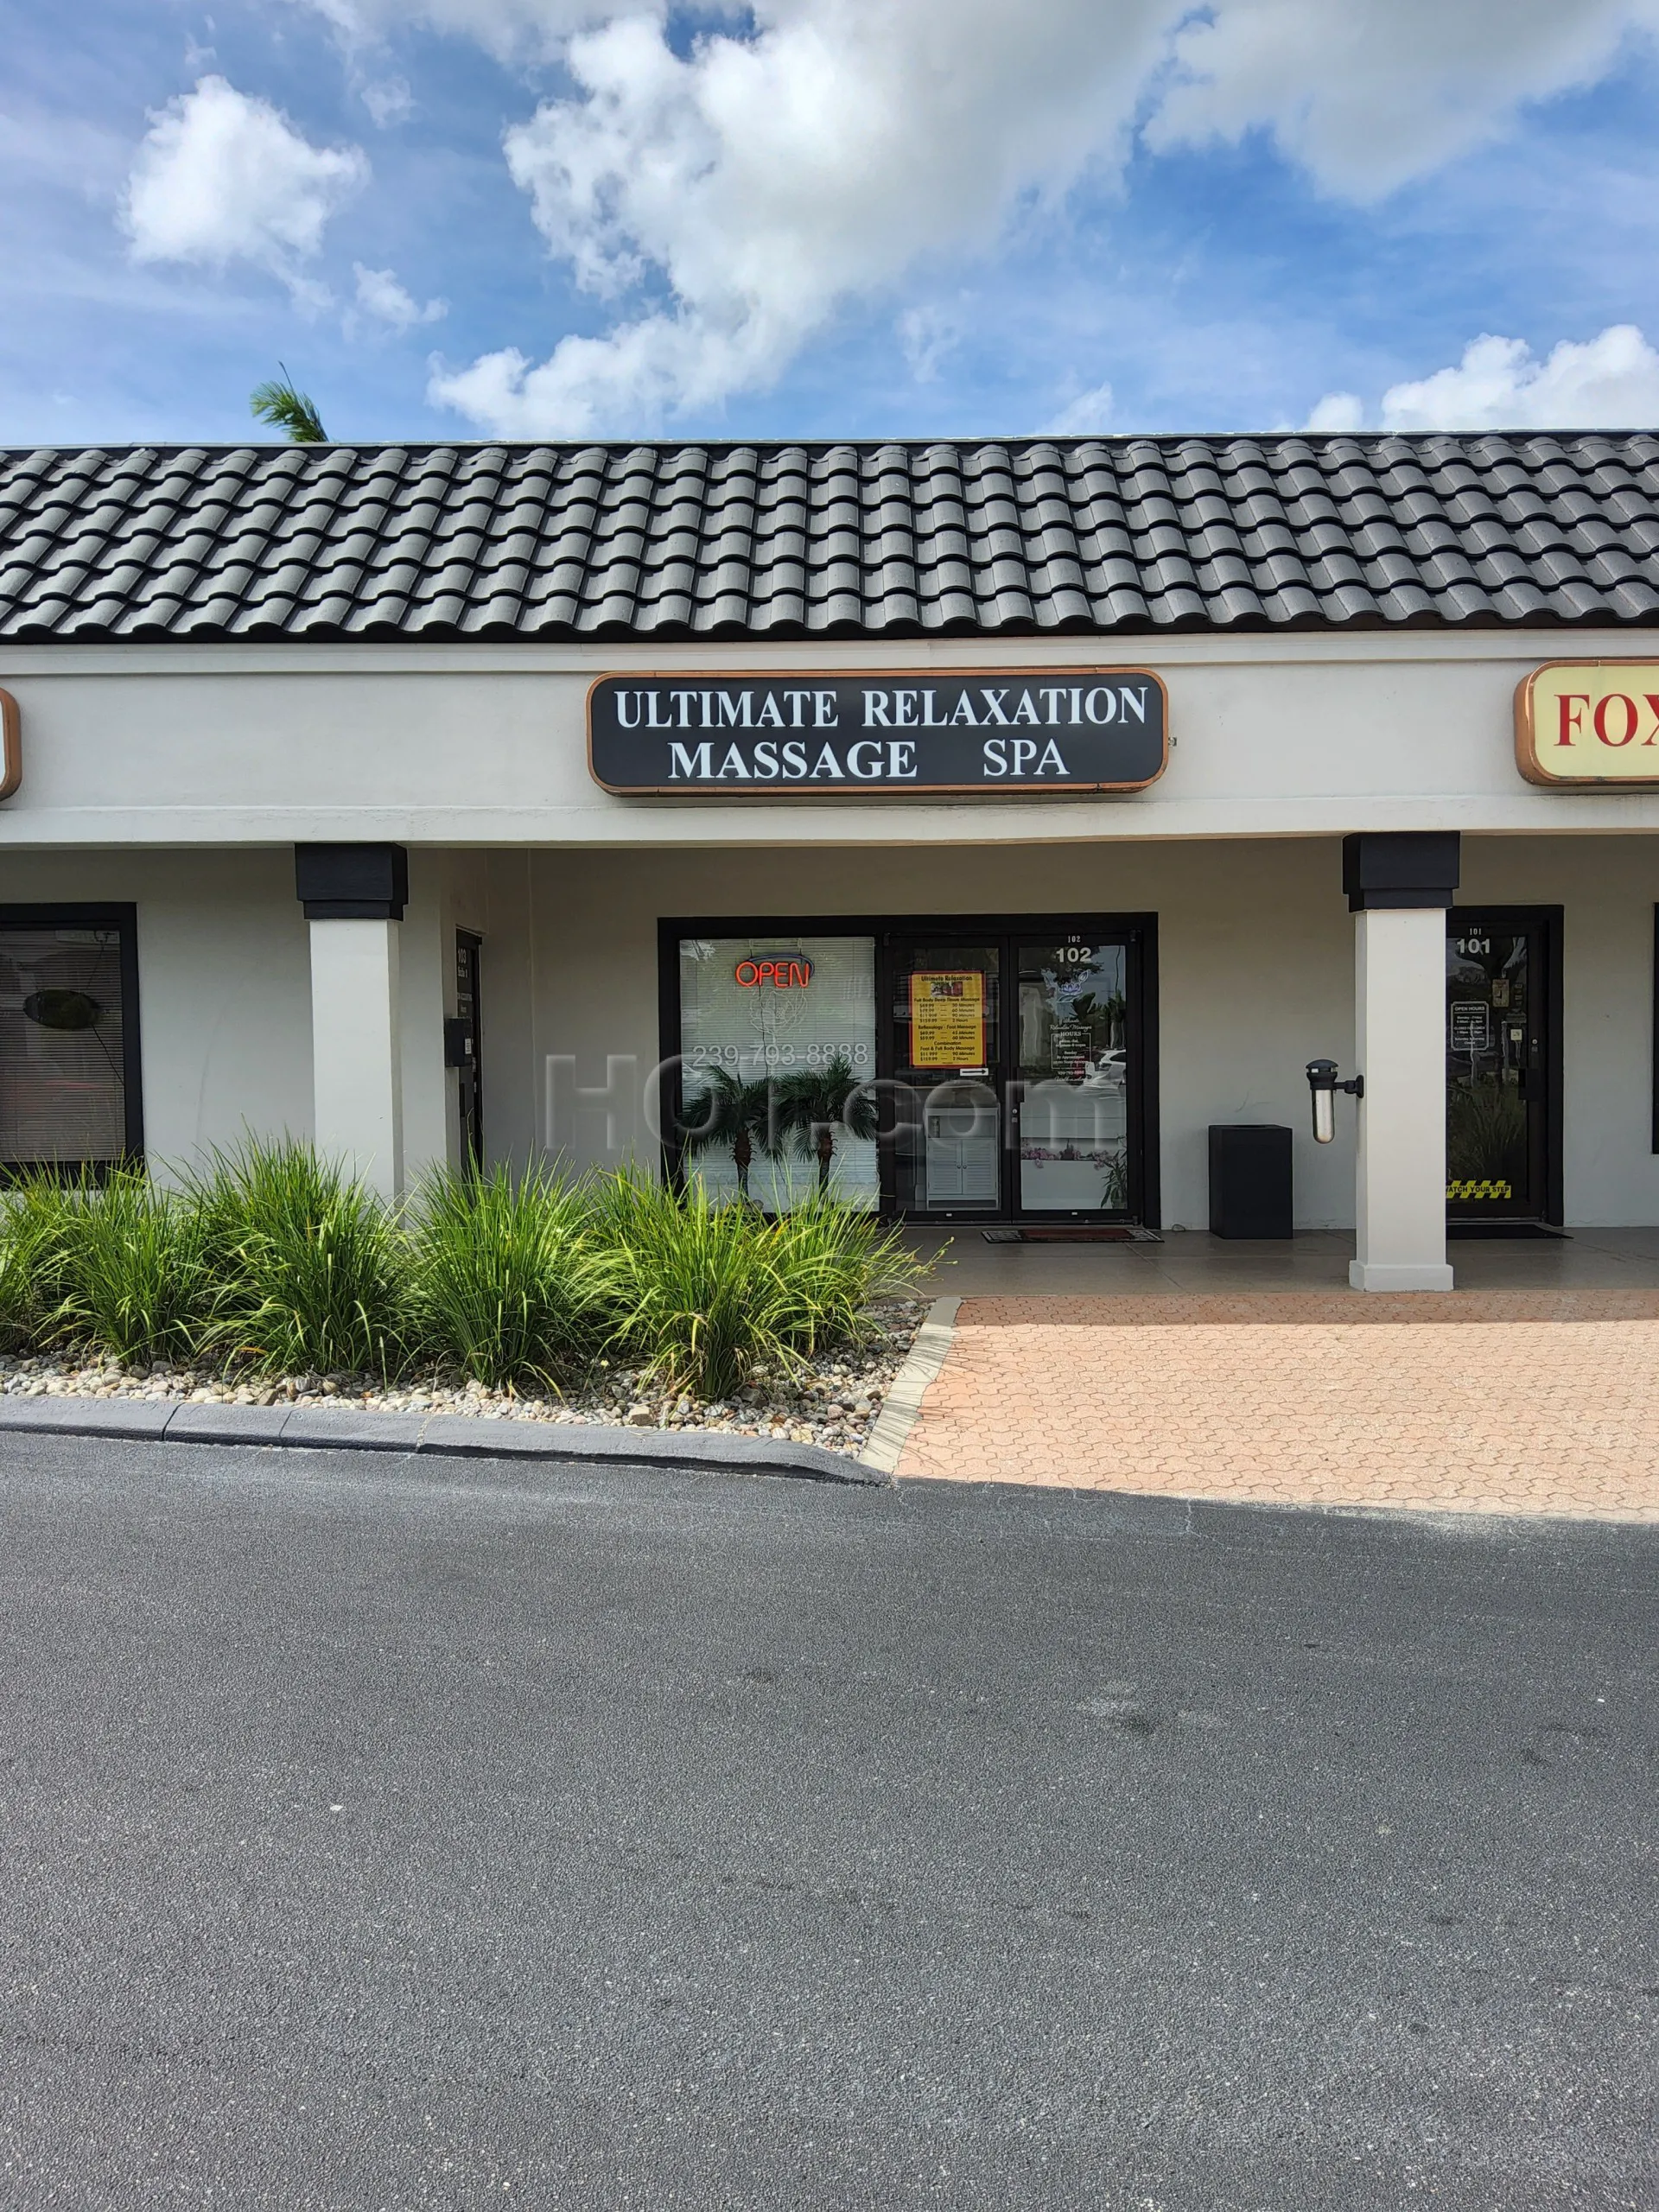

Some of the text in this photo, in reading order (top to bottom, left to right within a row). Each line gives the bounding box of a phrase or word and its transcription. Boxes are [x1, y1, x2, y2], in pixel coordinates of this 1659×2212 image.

[614, 686, 1148, 728] ULTIMATE RELAXATION
[667, 737, 1071, 779] MASSAGE SPA
[1470, 927, 1482, 936] 101
[457, 947, 467, 964] 103
[1056, 947, 1091, 963] 102
[1456, 938, 1490, 954] 101
[735, 961, 810, 988] OPEN
[692, 1044, 868, 1067] 239-793-8888
